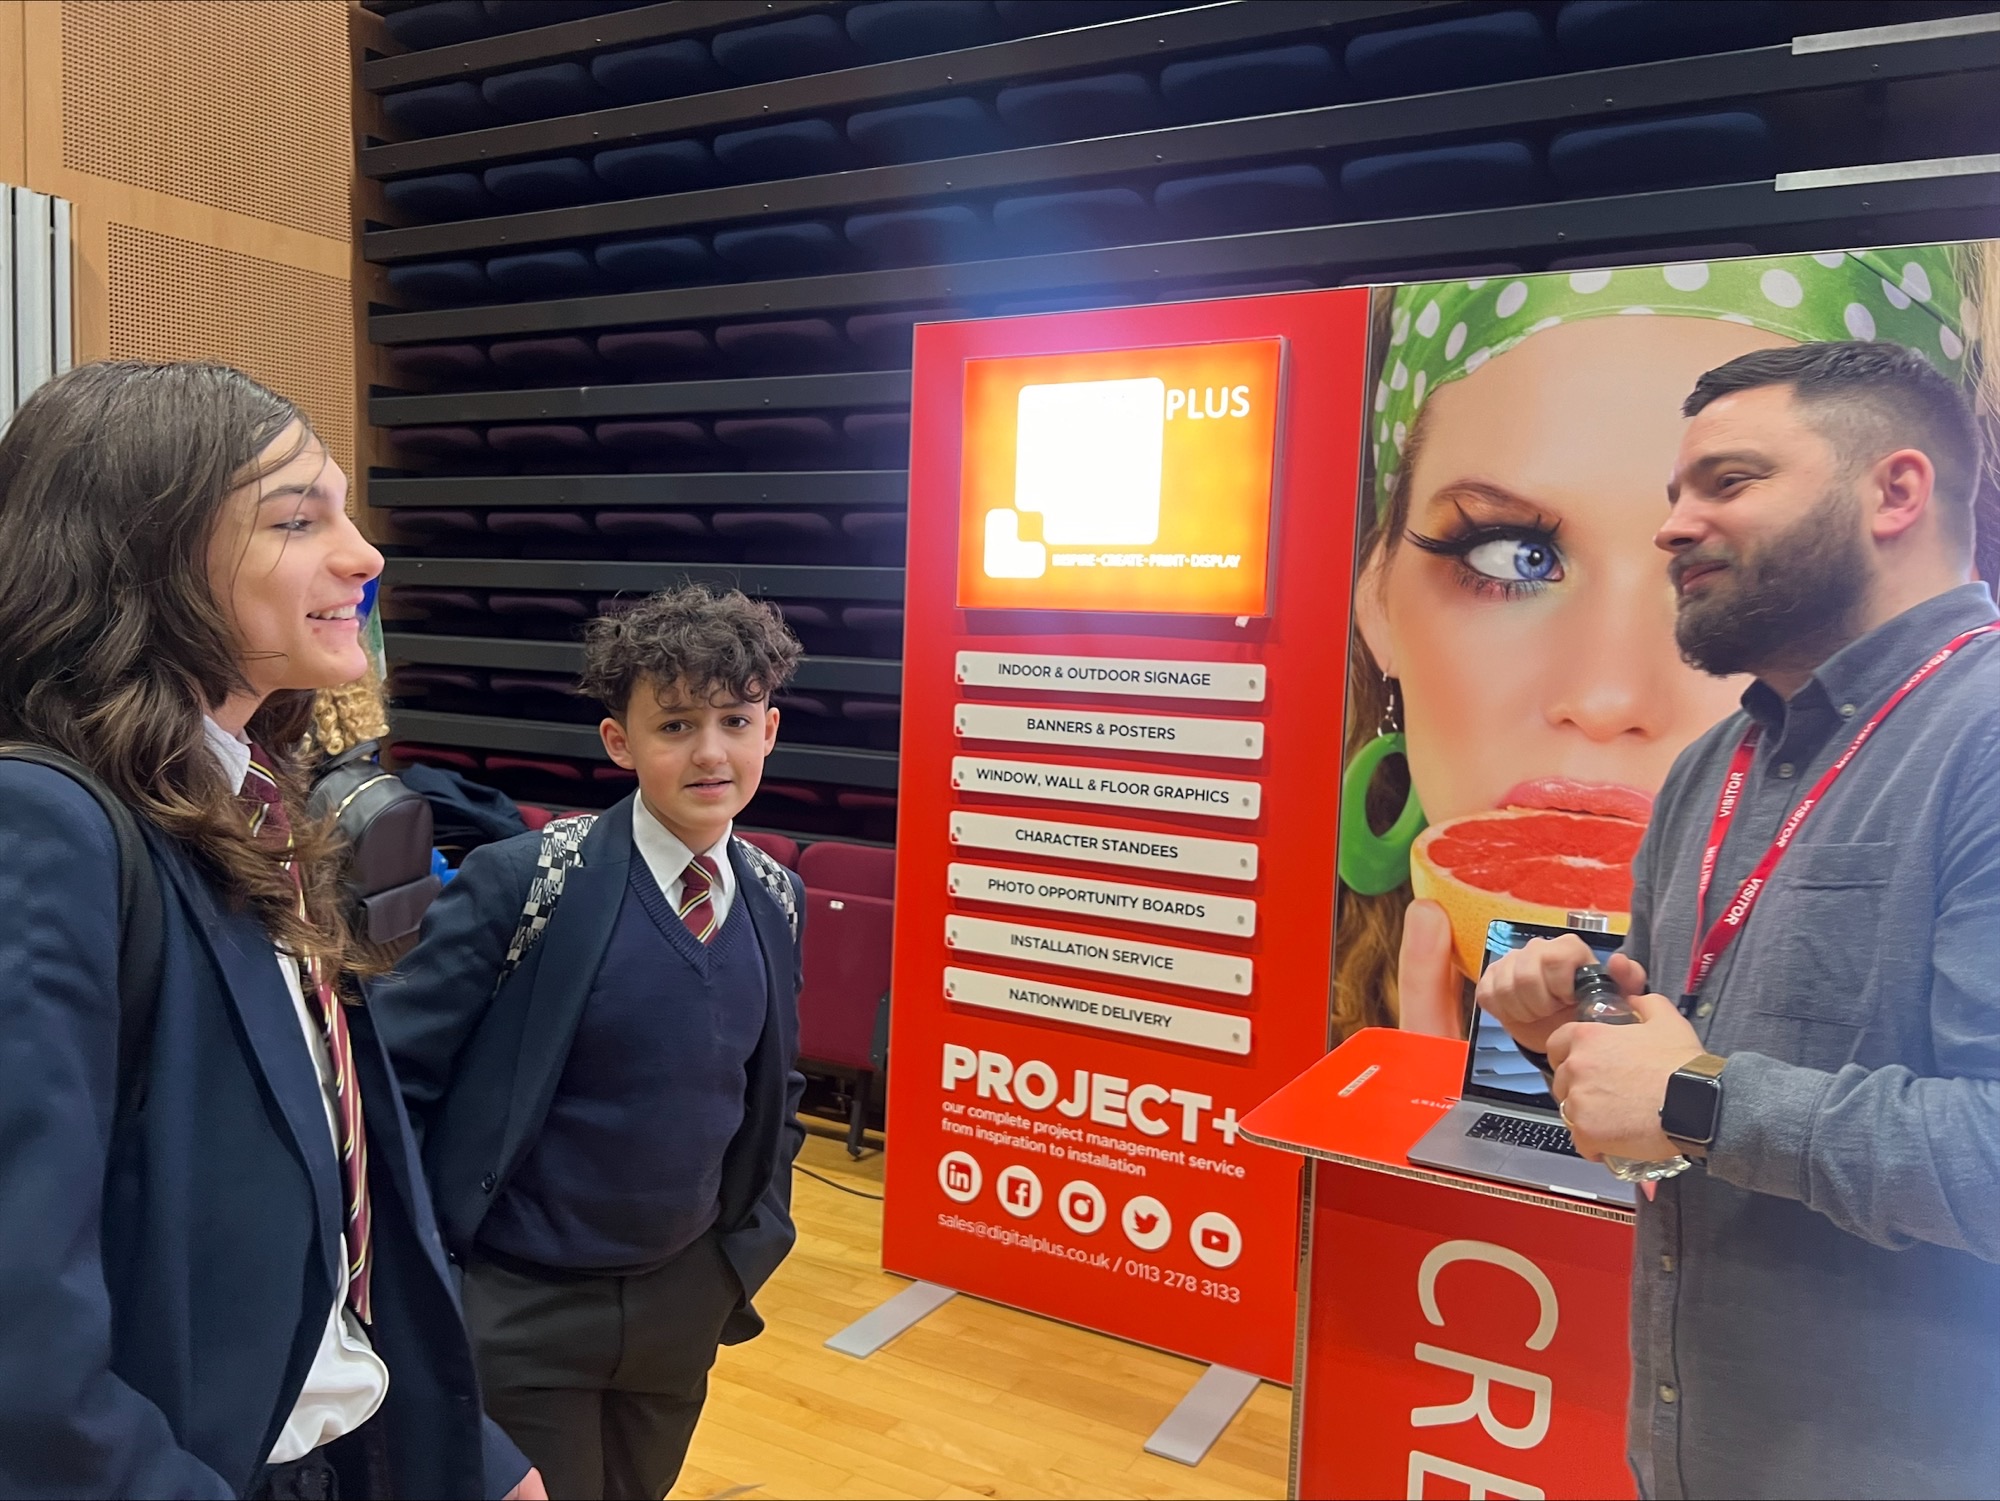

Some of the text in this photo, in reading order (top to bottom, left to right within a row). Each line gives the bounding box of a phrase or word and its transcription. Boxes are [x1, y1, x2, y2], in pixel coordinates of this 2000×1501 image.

[1165, 384, 1250, 420] PLUS
[998, 663, 1211, 686] INDOOR & OUTDOOR SIGNAGE
[1027, 718, 1176, 740] BANNERS & POSTERS
[976, 768, 1230, 804] WINDOW, WALL & FLOOR GRAPHICS
[1719, 771, 1744, 818] VISITOR
[1776, 799, 1814, 849] VISITOR
[1015, 829, 1178, 859] CHARACTER STANDEES
[988, 879, 1206, 918] PHOTO OPPORTUNITY BOARDS
[1723, 878, 1764, 926] VISITOR
[1011, 934, 1175, 970] INSTALLATION SERVICE
[1009, 988, 1172, 1028] NATIONWIDE DELIVERY
[941, 1101, 1246, 1178] our complete project management service
[941, 1118, 1147, 1177] from inspiration to installation
[938, 1212, 1241, 1304] sales@digitalplus.co.uk / 0113 278 3133
